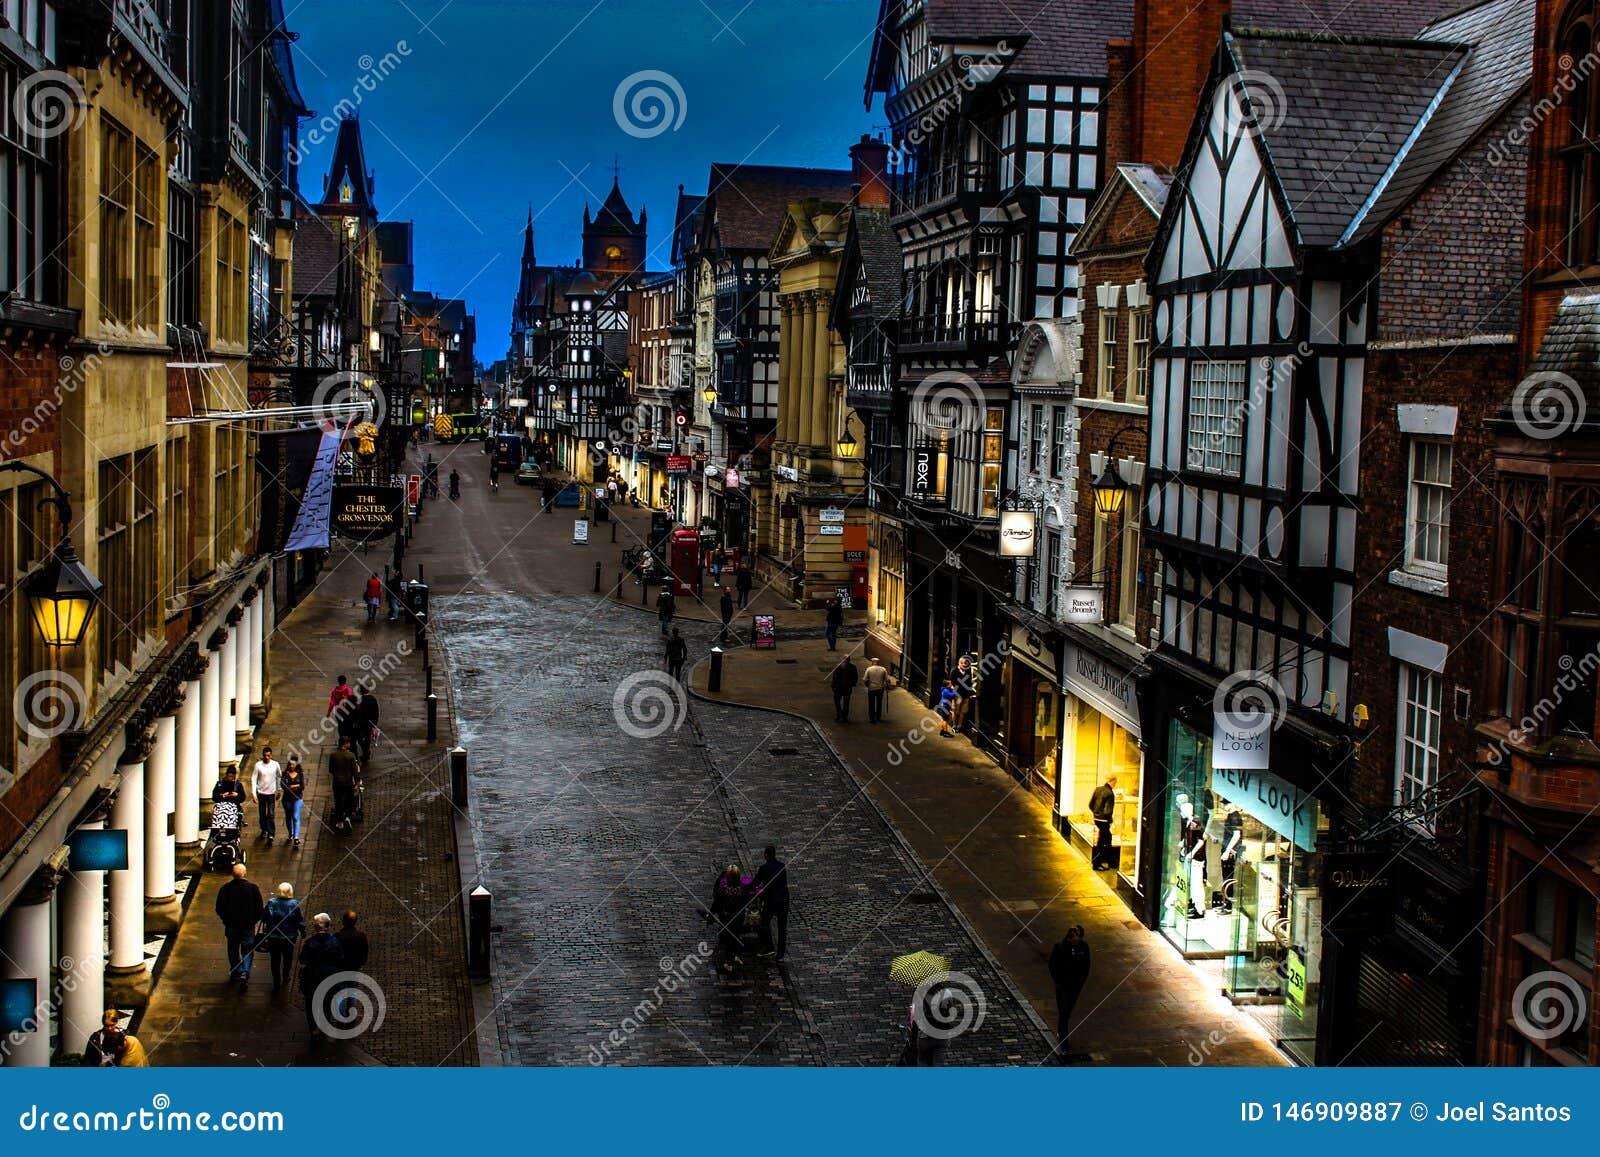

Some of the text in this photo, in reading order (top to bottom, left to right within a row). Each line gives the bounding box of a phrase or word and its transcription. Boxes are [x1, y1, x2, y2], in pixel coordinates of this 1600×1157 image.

[917, 452, 930, 489] next
[356, 495, 376, 503] THE
[345, 504, 386, 513] CHESTER
[337, 513, 394, 523] GROSVENOR
[1072, 599, 1095, 607] Russell
[1225, 731, 1262, 741] NEW
[1221, 741, 1265, 751] LOOK
[1258, 779, 1304, 825] LOOK
